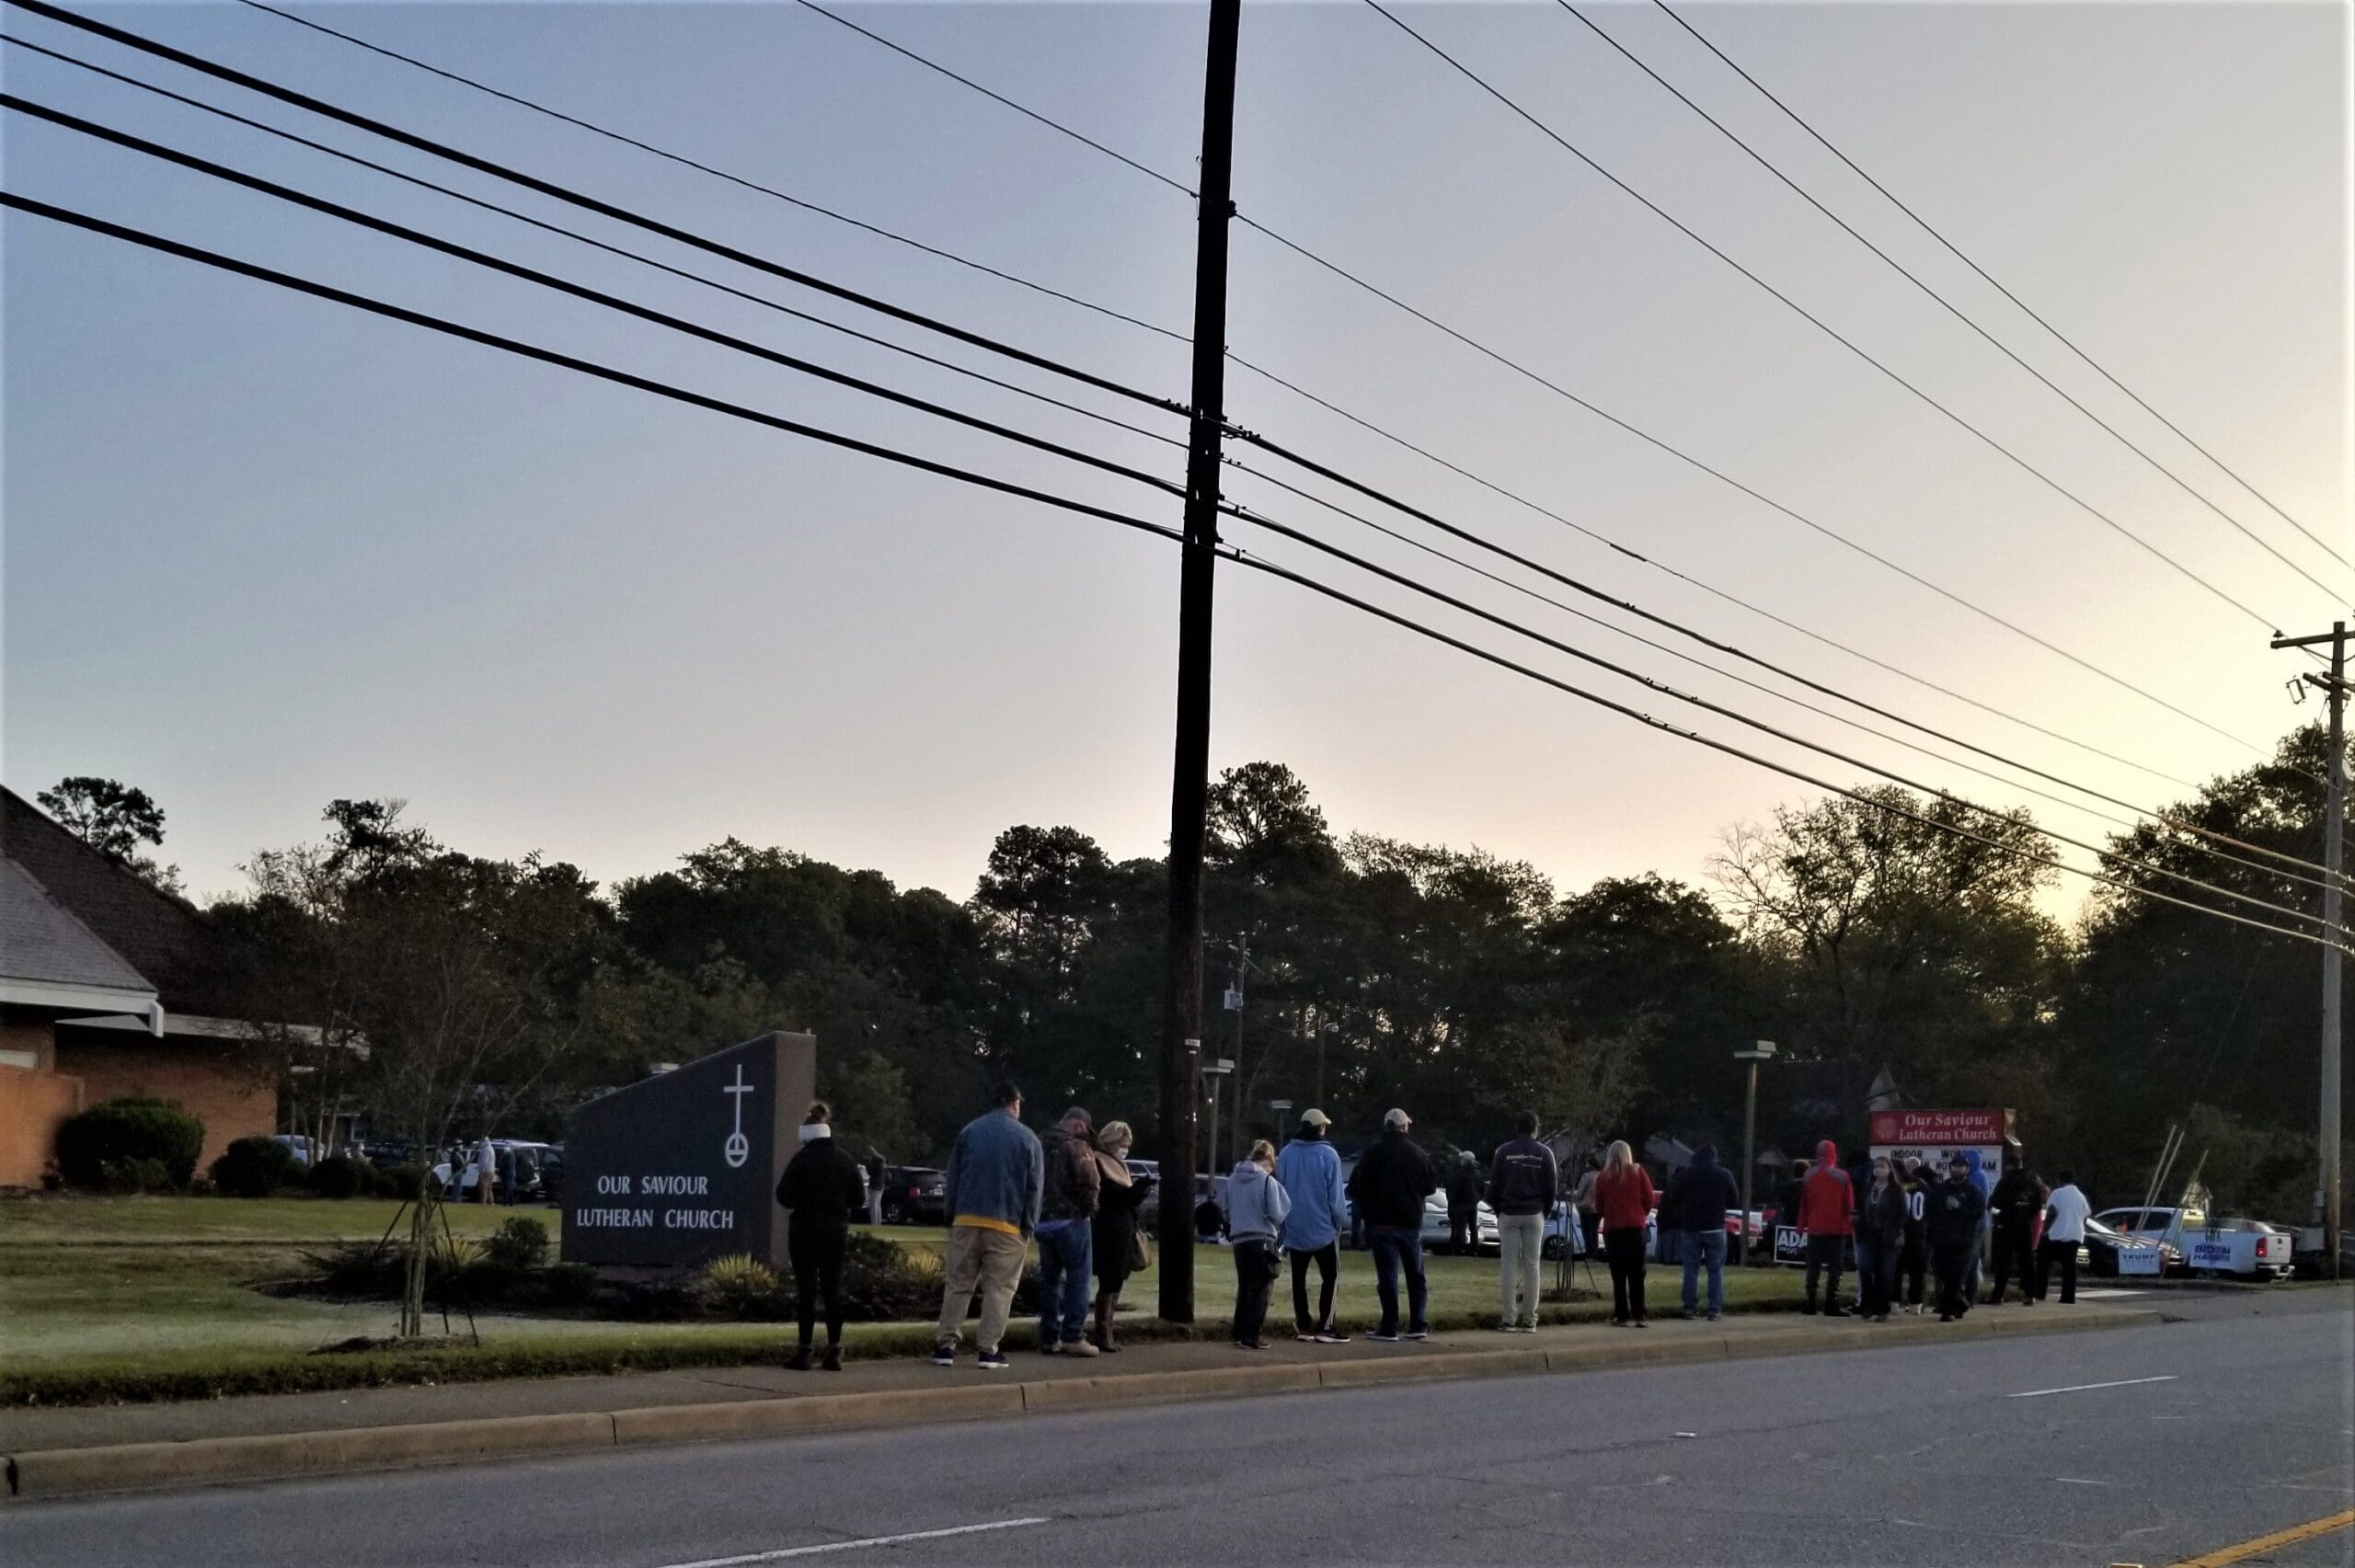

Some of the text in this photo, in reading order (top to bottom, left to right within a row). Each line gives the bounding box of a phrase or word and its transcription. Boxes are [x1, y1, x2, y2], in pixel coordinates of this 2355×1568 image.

[1905, 1113, 1991, 1127] Our Saviour
[1899, 1127, 1997, 1140] Lutheran Church
[1890, 1150, 1923, 1159] INDOOR
[598, 1176, 707, 1195] OUR SAVIOUR
[577, 1208, 733, 1229] LUTHERAN CHURCH
[1776, 1230, 1809, 1248] ADA
